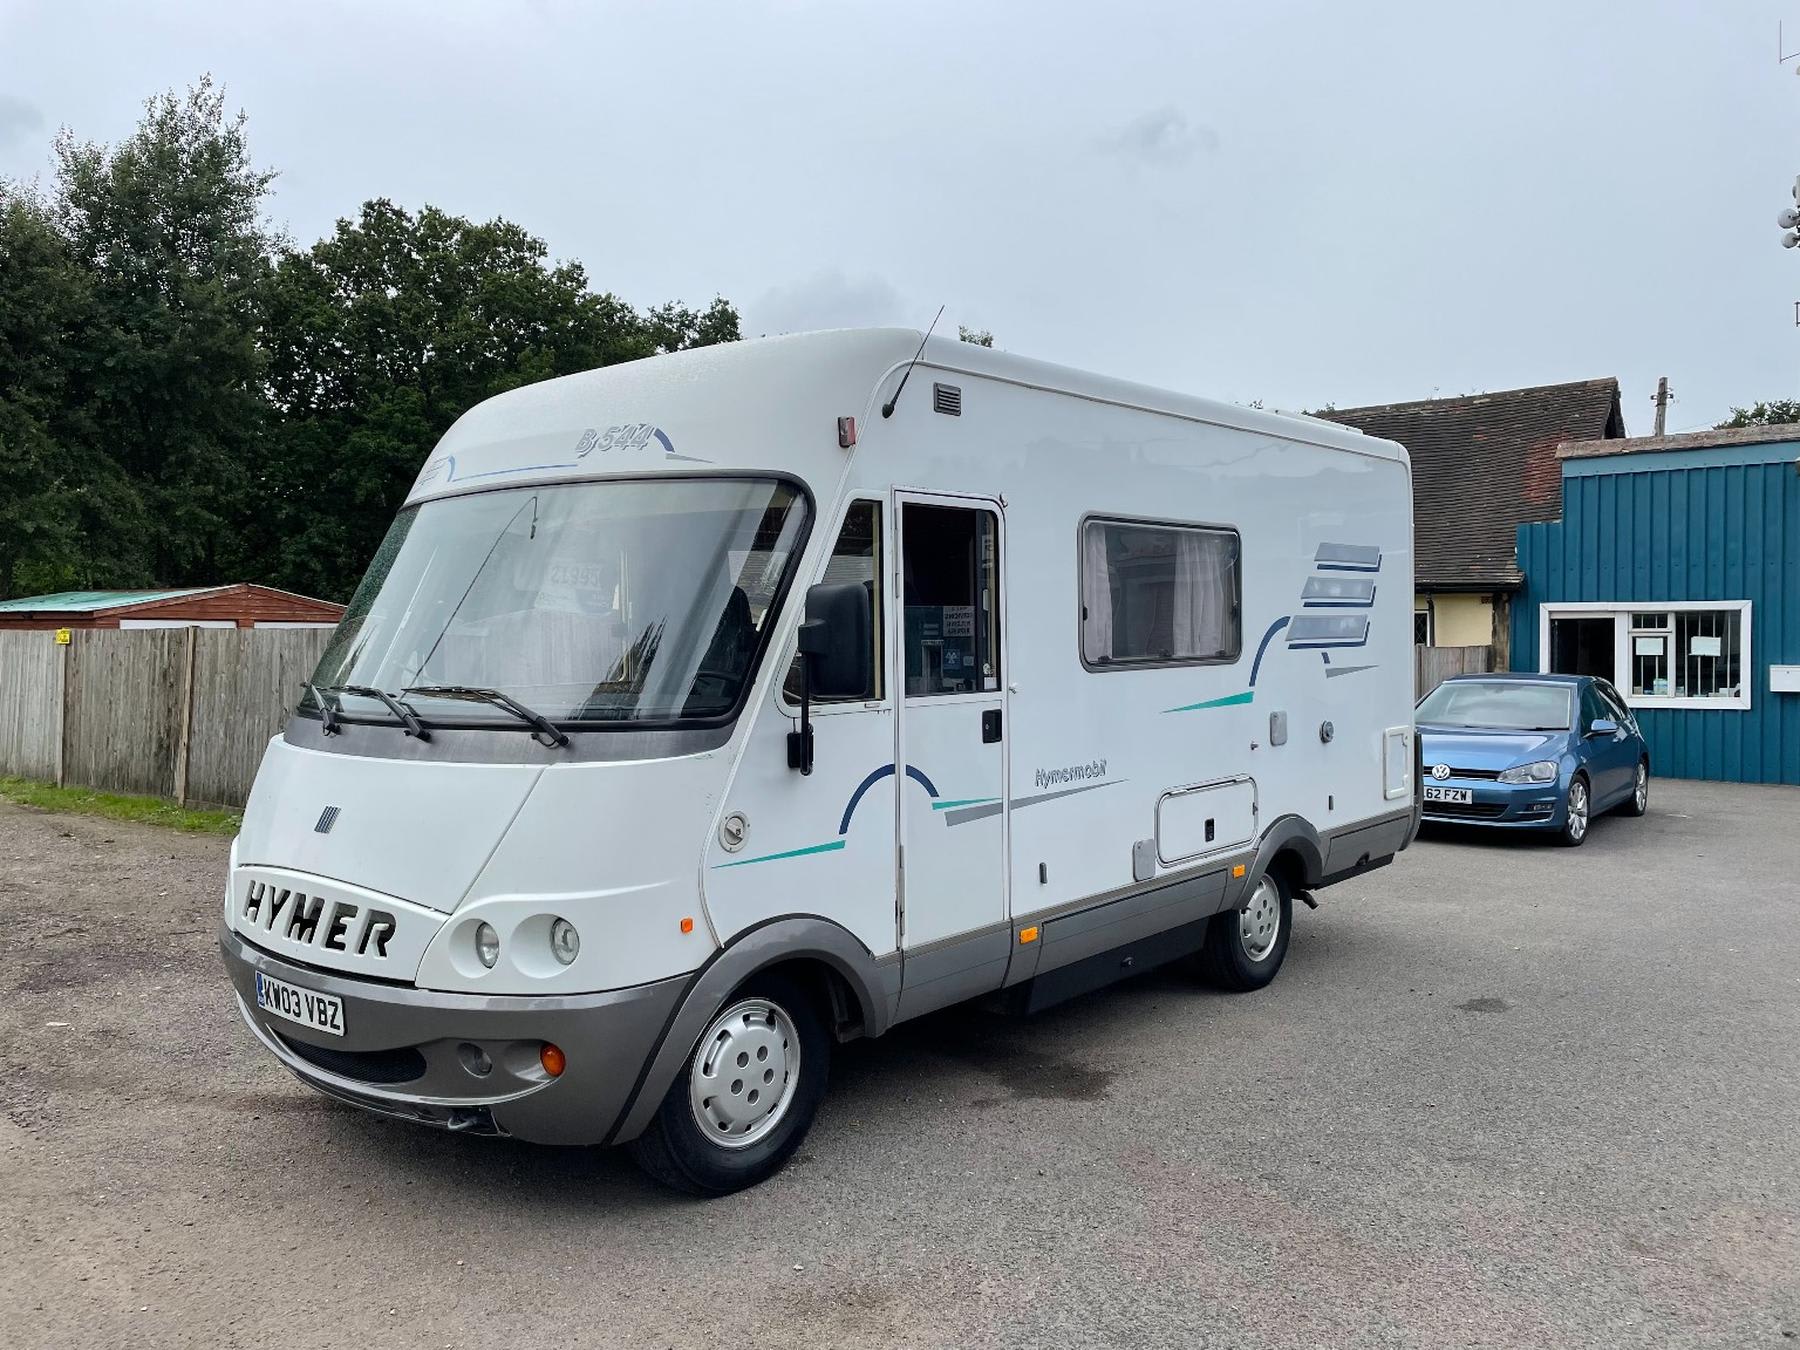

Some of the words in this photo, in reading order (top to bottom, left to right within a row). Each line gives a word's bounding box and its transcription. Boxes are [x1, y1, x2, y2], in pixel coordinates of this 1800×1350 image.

[575, 428, 598, 454] B
[598, 423, 655, 452] 544
[1424, 788, 1441, 799] 62
[1444, 789, 1467, 801] FZW
[241, 880, 397, 960] HYMER
[263, 978, 302, 1018] KW03
[305, 993, 341, 1031] VBZ
